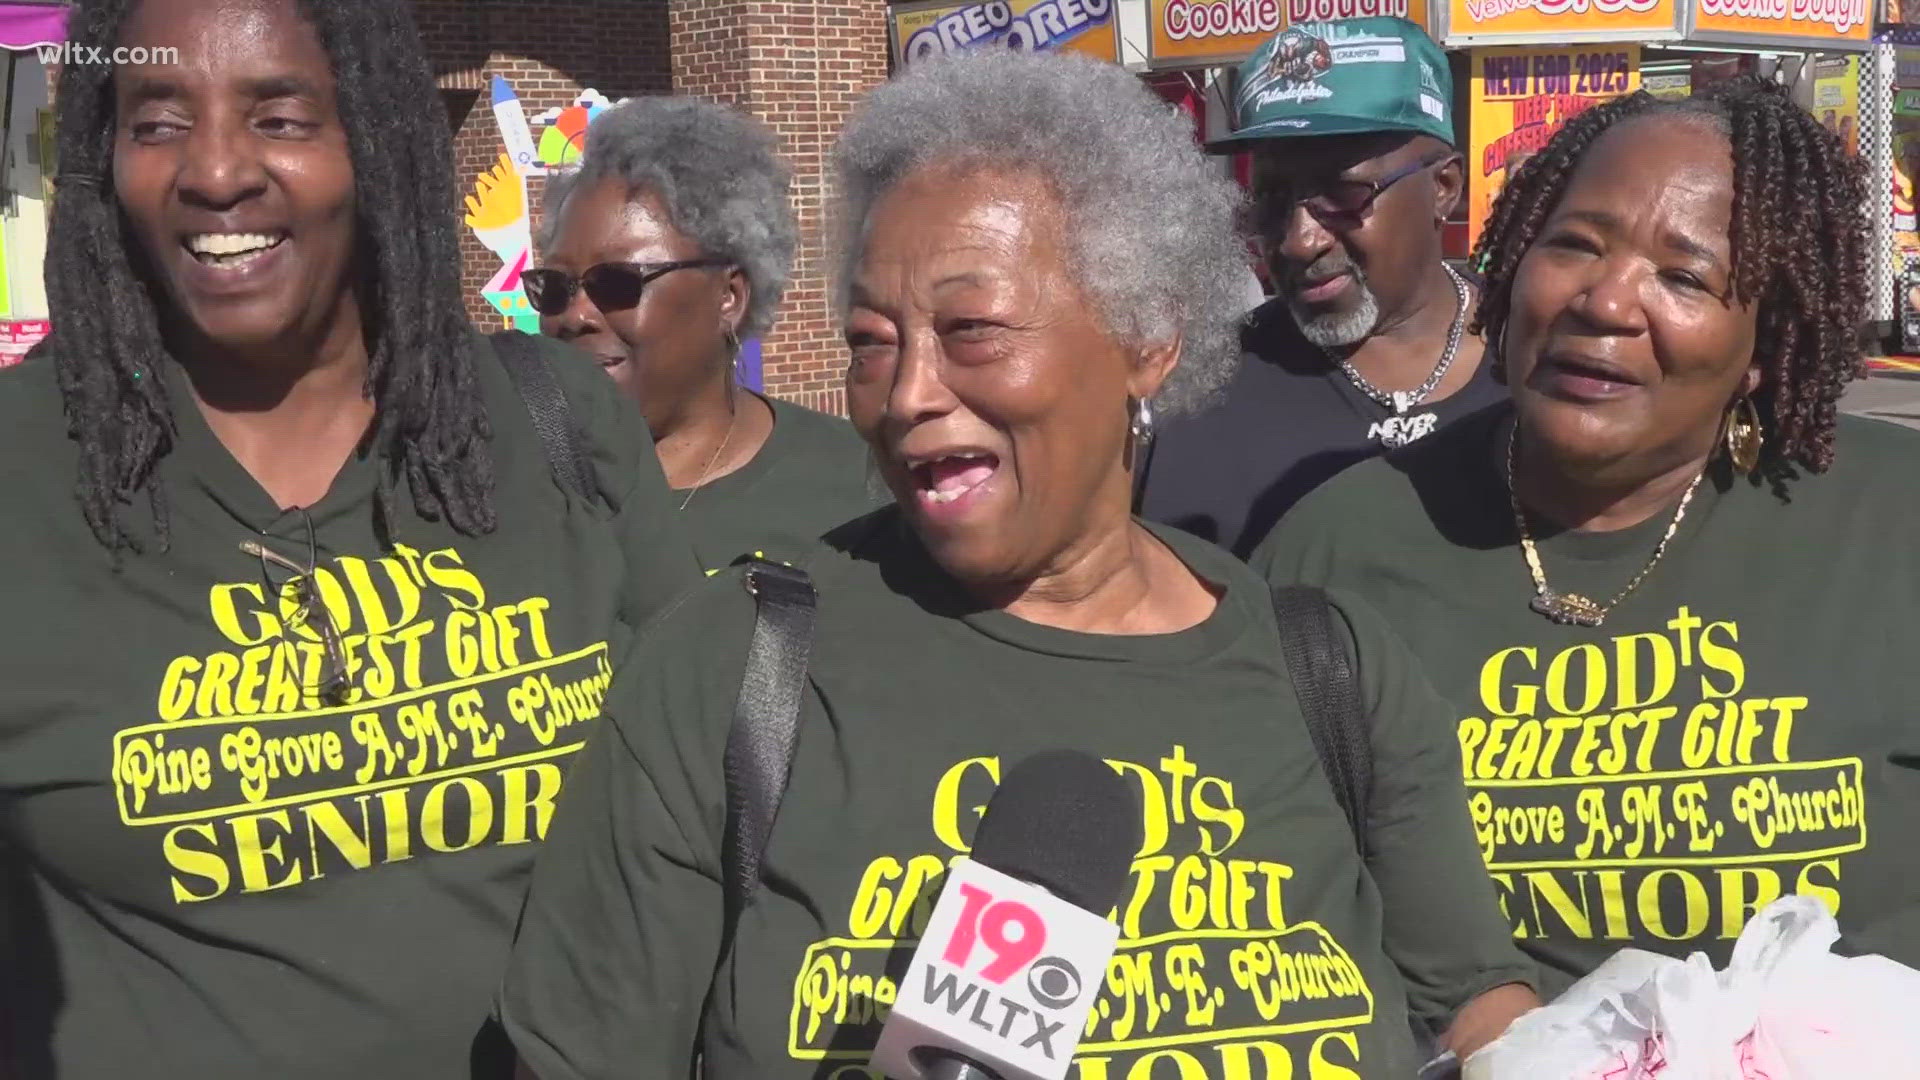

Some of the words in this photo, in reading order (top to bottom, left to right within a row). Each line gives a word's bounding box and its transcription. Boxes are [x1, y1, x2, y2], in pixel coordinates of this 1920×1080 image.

[907, 2, 1010, 65] OREO
[1166, 0, 1280, 40] Cookie
[1255, 80, 1334, 112] Philadelphia
[1484, 55, 1529, 95] NEW
[1533, 54, 1571, 94] FOR
[1575, 53, 1629, 94] 2025
[1513, 95, 1552, 130] DEEP
[1367, 413, 1437, 439] NEVER
[159, 620, 434, 720] GREATEST
[445, 597, 552, 678] GIFT
[121, 734, 211, 813] Pine
[220, 727, 343, 801] Grove
[351, 690, 505, 785] A.M.E.
[1458, 706, 1677, 779] REATEST
[1681, 696, 1808, 769] GIFT
[162, 762, 563, 903] SENIOR
[1468, 791, 1565, 864] Grove
[1575, 780, 1724, 859] A.M.E.
[1732, 771, 1859, 849] Church
[942, 882, 1047, 985] 19
[1169, 856, 1294, 930] GIFT
[923, 964, 1066, 1060] WLTX
[1229, 939, 1362, 1021] Church
